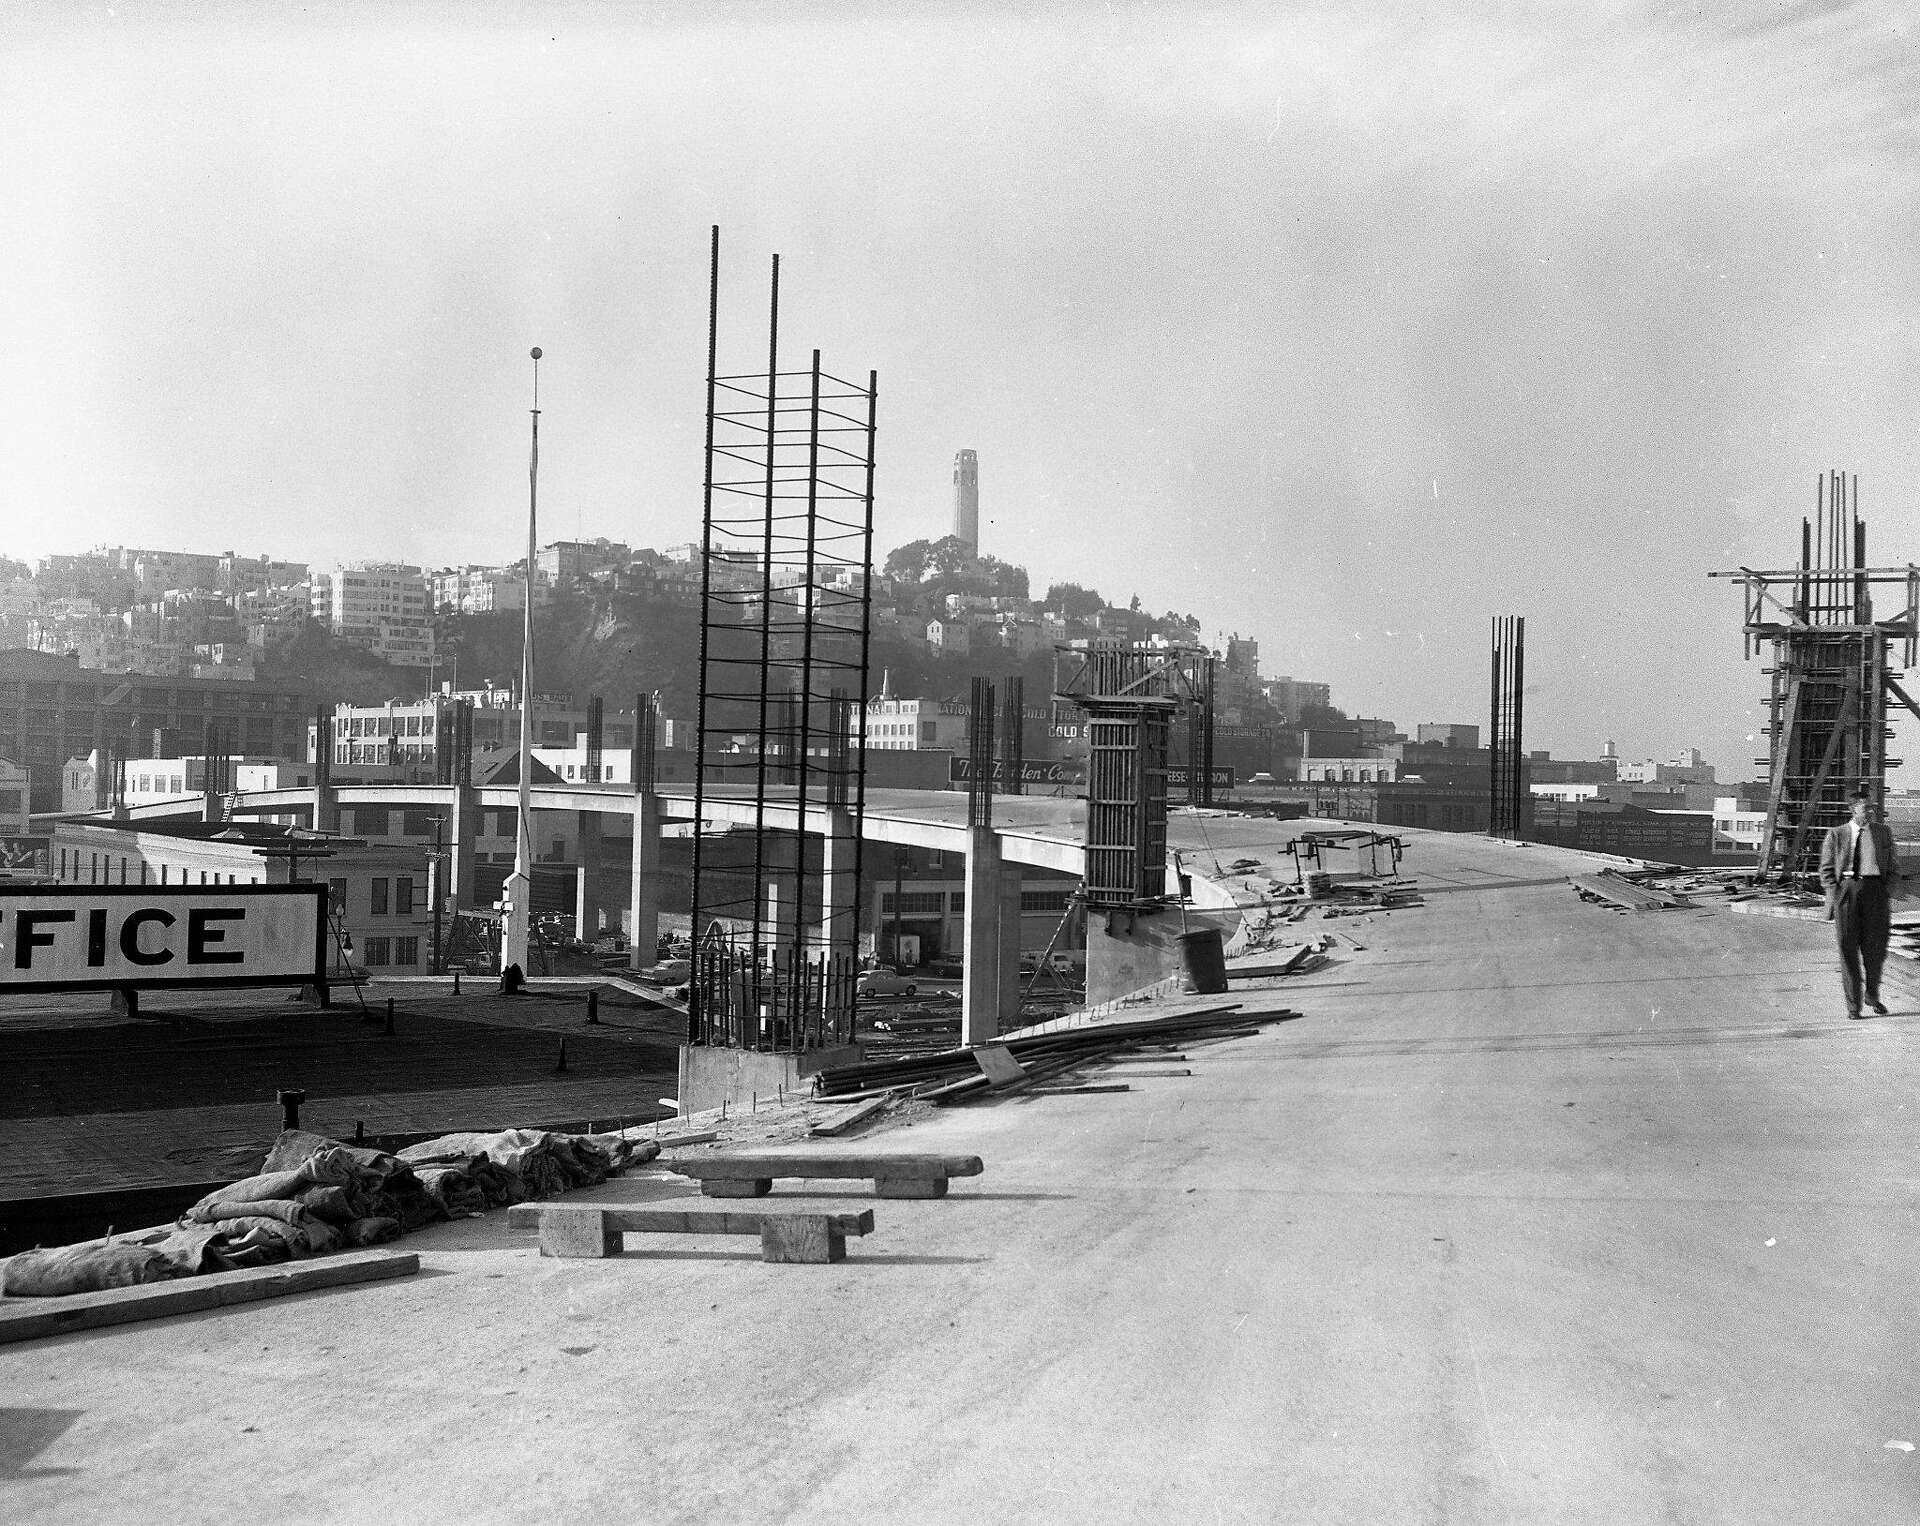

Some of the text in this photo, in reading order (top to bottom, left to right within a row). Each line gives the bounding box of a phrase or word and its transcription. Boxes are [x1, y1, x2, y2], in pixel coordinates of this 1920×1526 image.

[1048, 725, 1077, 738] COLD
[959, 760, 983, 778] Te
[992, 760, 1041, 780] Bden
[1167, 771, 1186, 783] EESE
[0, 907, 246, 969] FICE
